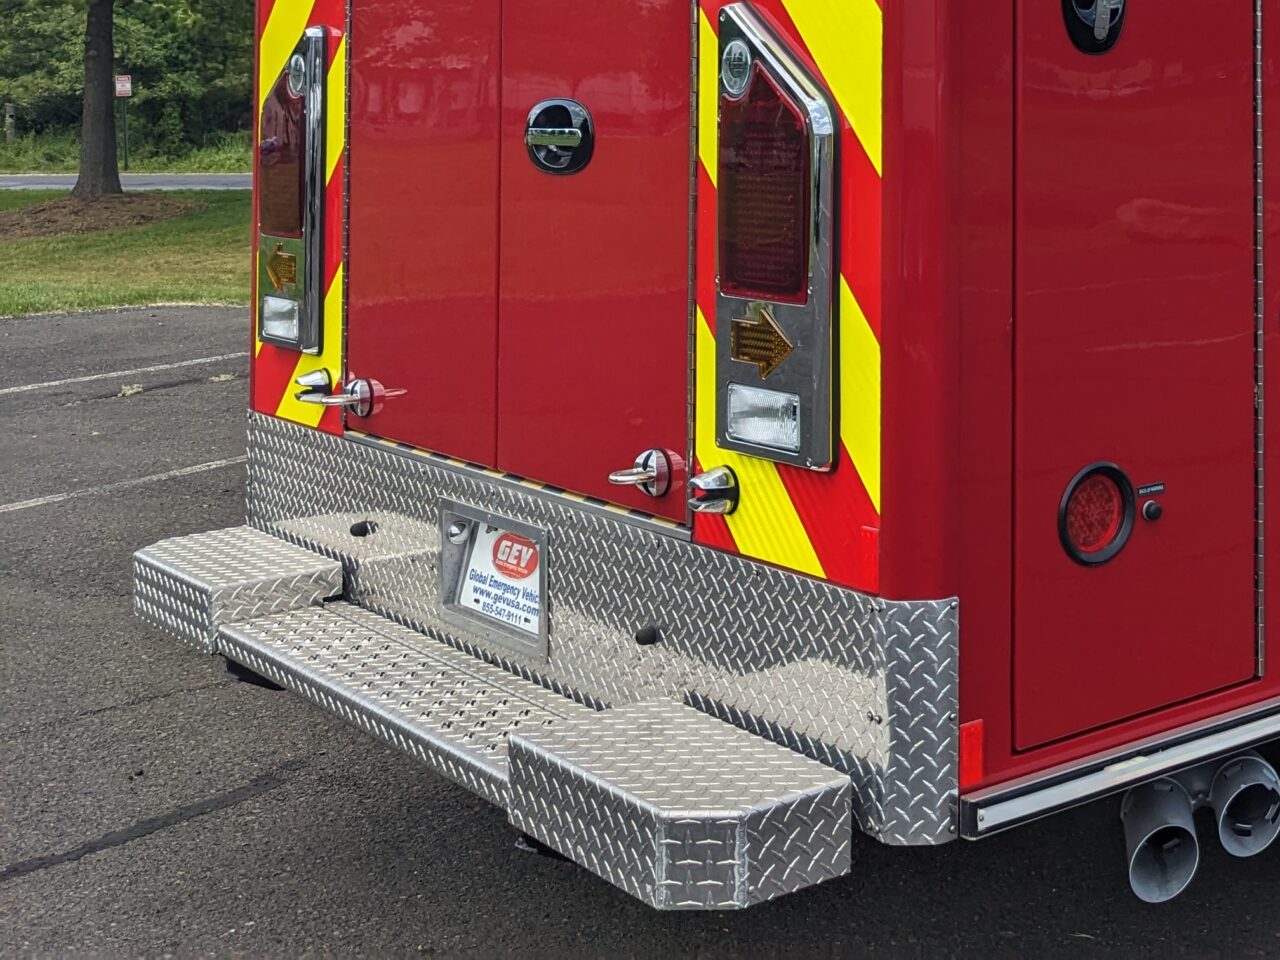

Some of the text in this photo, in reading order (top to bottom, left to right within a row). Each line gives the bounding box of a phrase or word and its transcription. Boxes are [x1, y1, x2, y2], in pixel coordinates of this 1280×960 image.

[497, 539, 533, 567] GEV
[469, 568, 540, 604] Global Emergency Vehic
[473, 585, 539, 616] www.gevusa.com
[482, 601, 522, 624] 855-547-9111
